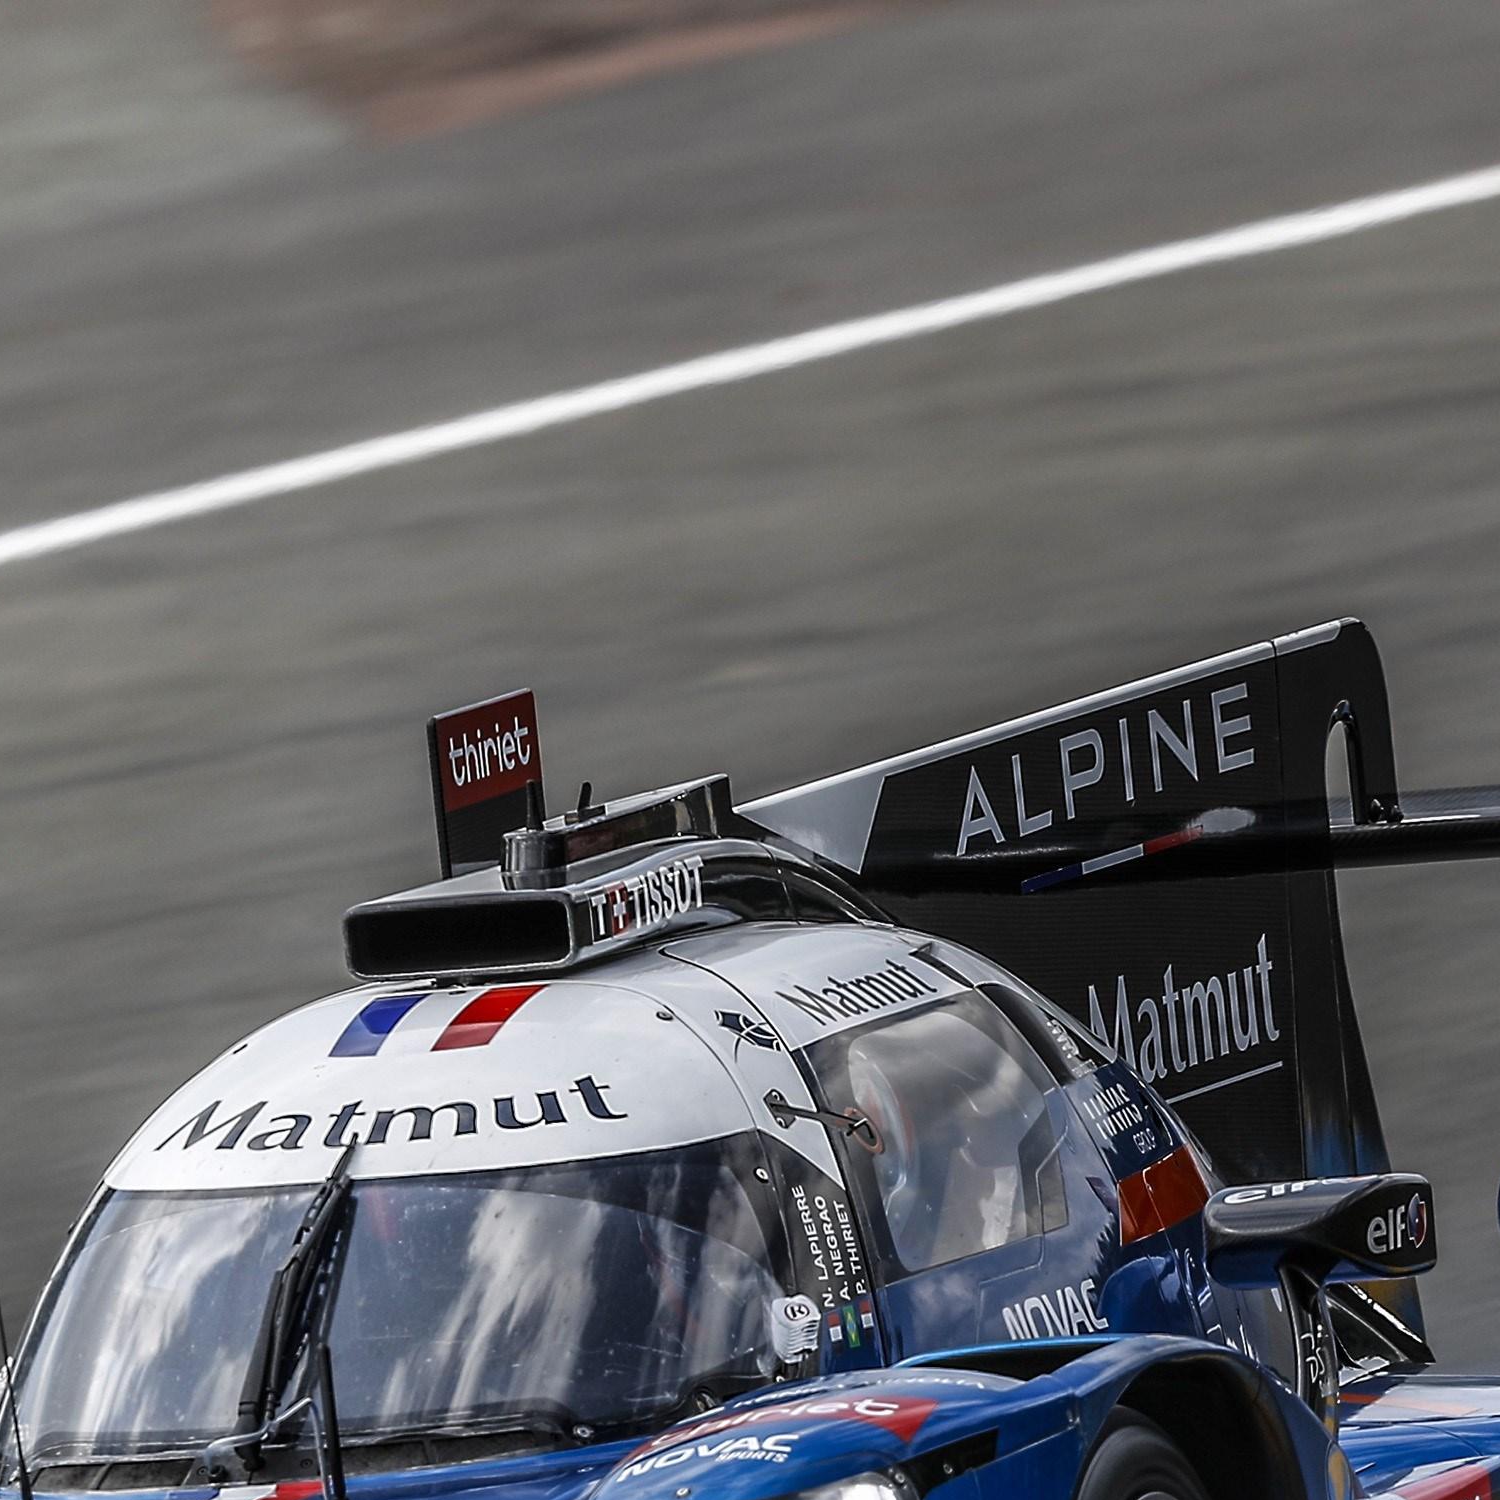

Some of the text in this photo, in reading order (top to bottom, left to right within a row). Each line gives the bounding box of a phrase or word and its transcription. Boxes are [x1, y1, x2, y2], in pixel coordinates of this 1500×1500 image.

[448, 716, 532, 788] thiriet
[955, 683, 1256, 857] ALPINE
[623, 855, 704, 929] TISSOT
[775, 958, 939, 1027] Matmut
[1087, 934, 1281, 1084] Matmut
[154, 1074, 628, 1152] Matmut
[791, 1184, 836, 1308] N. LAPIERRE
[814, 1195, 852, 1301] A. NEGRAO
[833, 1200, 867, 1294] P. THIRIET
[1366, 1204, 1408, 1254] elf
[1002, 1278, 1109, 1340] NOVAC
[616, 1433, 800, 1483] NOVAC
[714, 1450, 789, 1465] SPORTS
